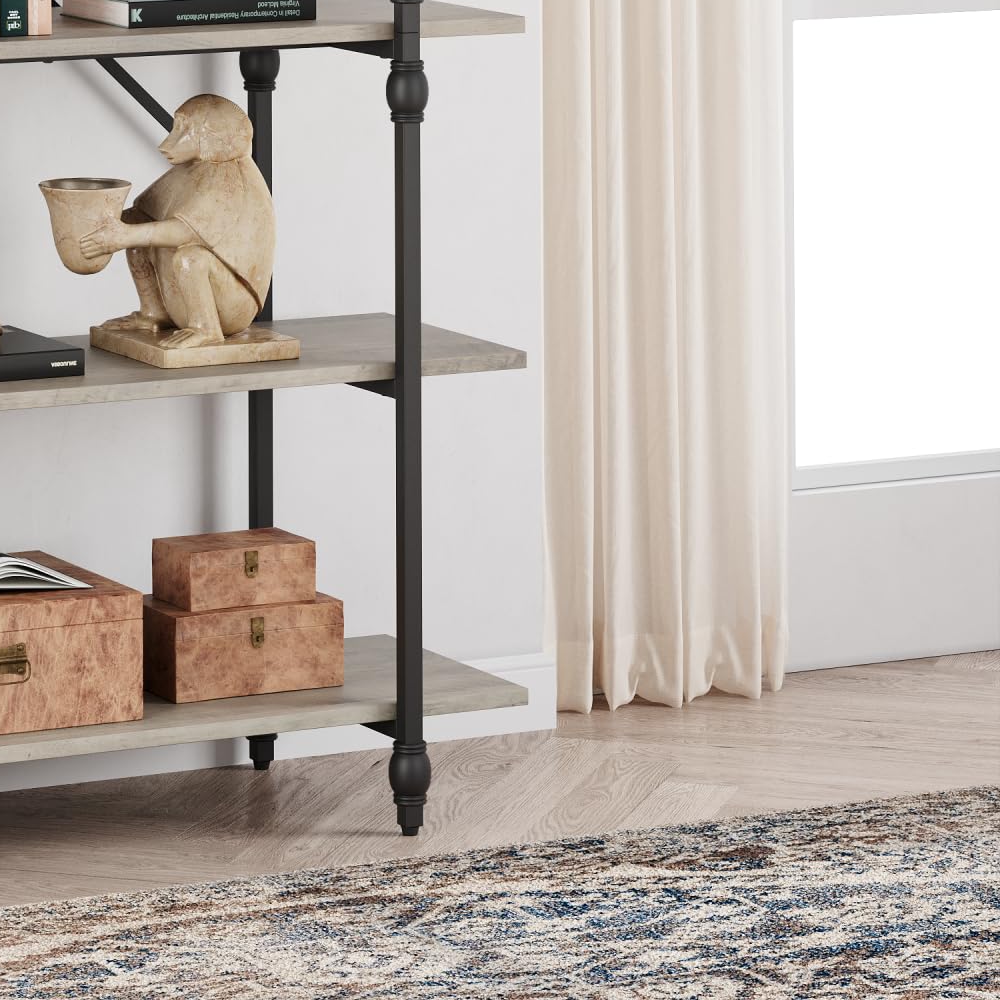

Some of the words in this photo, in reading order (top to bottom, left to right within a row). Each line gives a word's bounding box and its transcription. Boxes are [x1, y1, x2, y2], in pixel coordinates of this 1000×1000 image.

[280, 0, 300, 8] Virginia
[176, 14, 208, 22] Architecture
[210, 12, 239, 20] Residential
[240, 10, 278, 19] Contemporary
